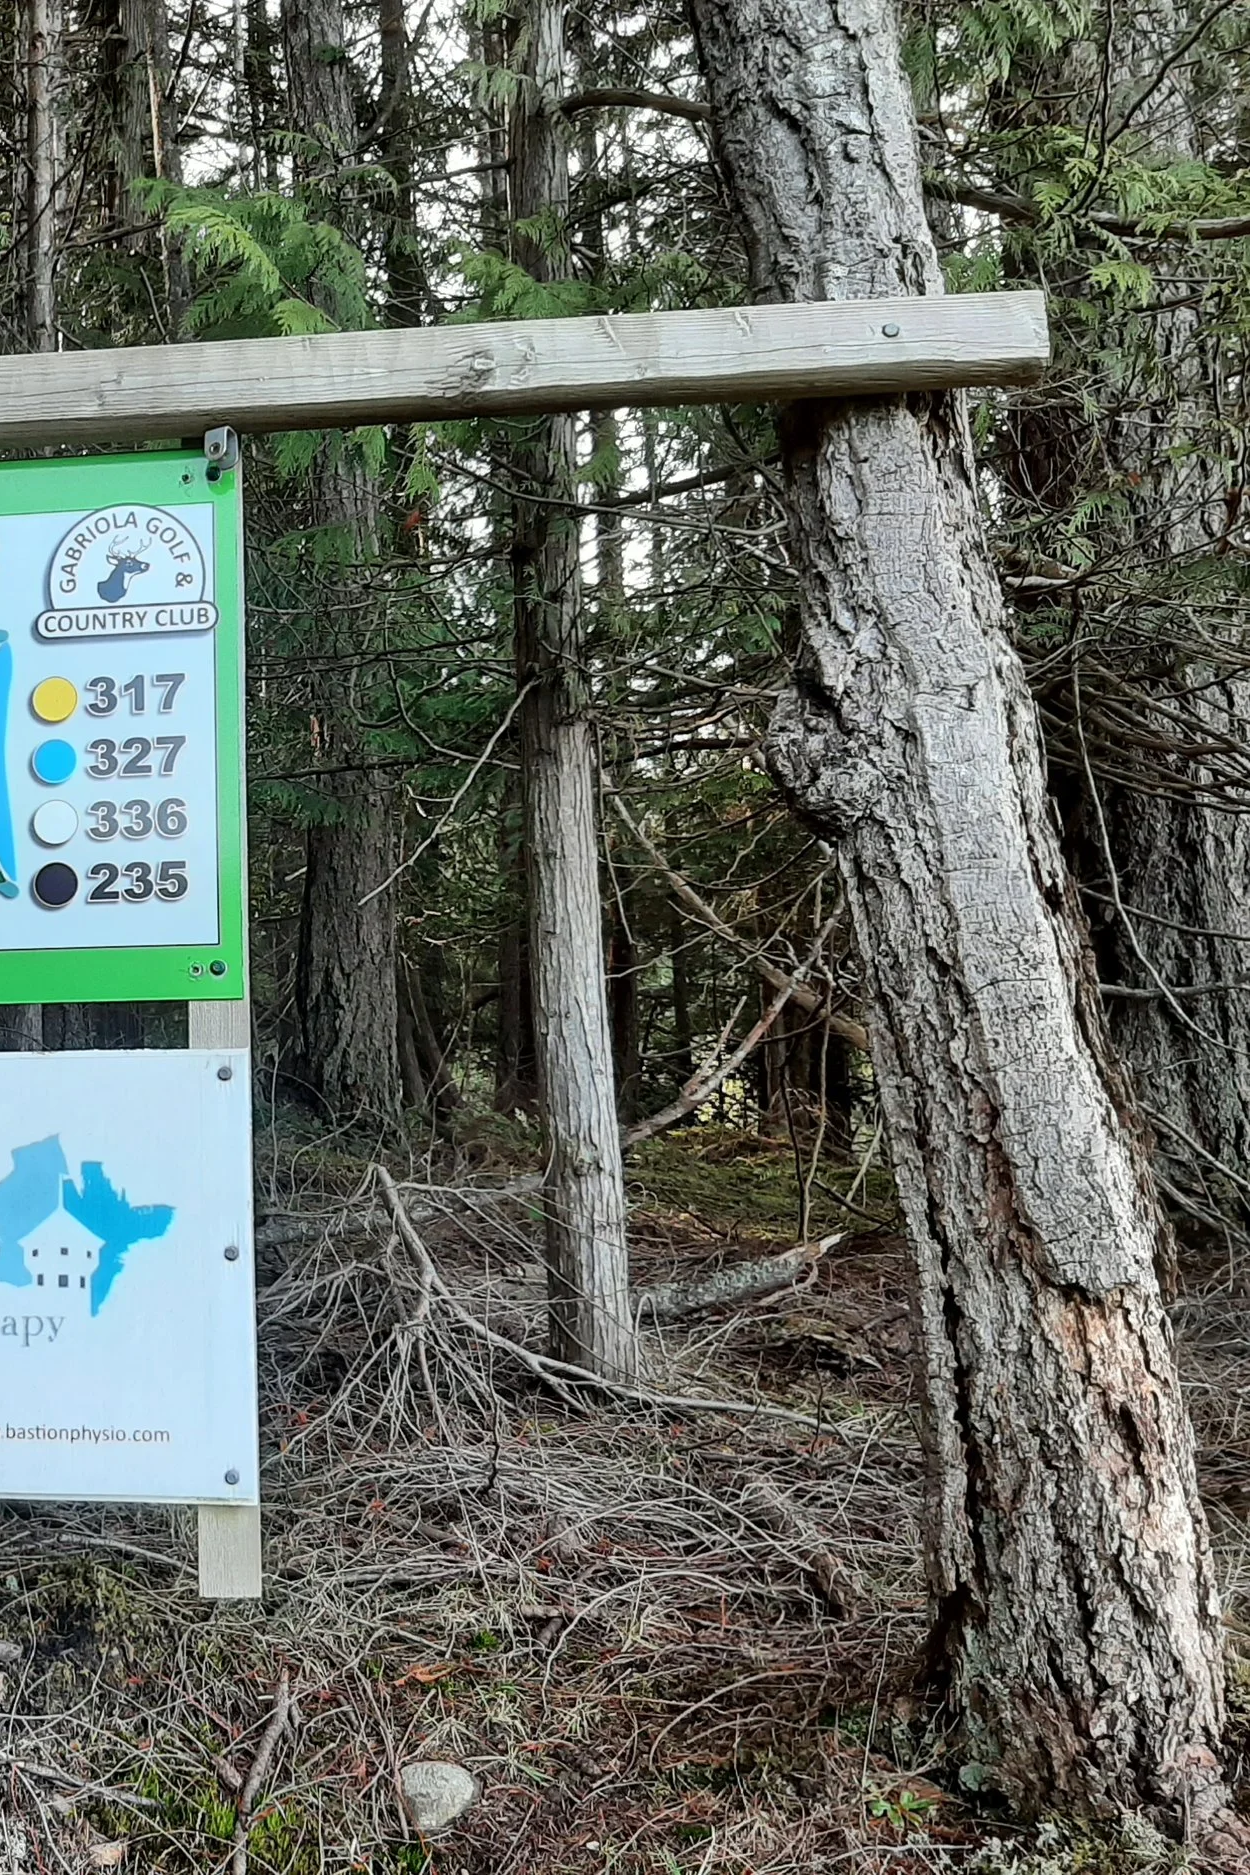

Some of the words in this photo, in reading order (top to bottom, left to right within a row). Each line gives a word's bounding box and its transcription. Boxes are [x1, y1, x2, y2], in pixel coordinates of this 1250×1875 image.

[59, 511, 138, 593] GABRIOLA
[146, 517, 191, 563] GOLF
[175, 572, 193, 588] &
[44, 610, 148, 633] COUNTRY
[155, 607, 210, 627] CLUB
[85, 672, 186, 716] 317
[85, 735, 187, 777] 327
[85, 798, 188, 839] 336
[88, 861, 189, 902] 235
